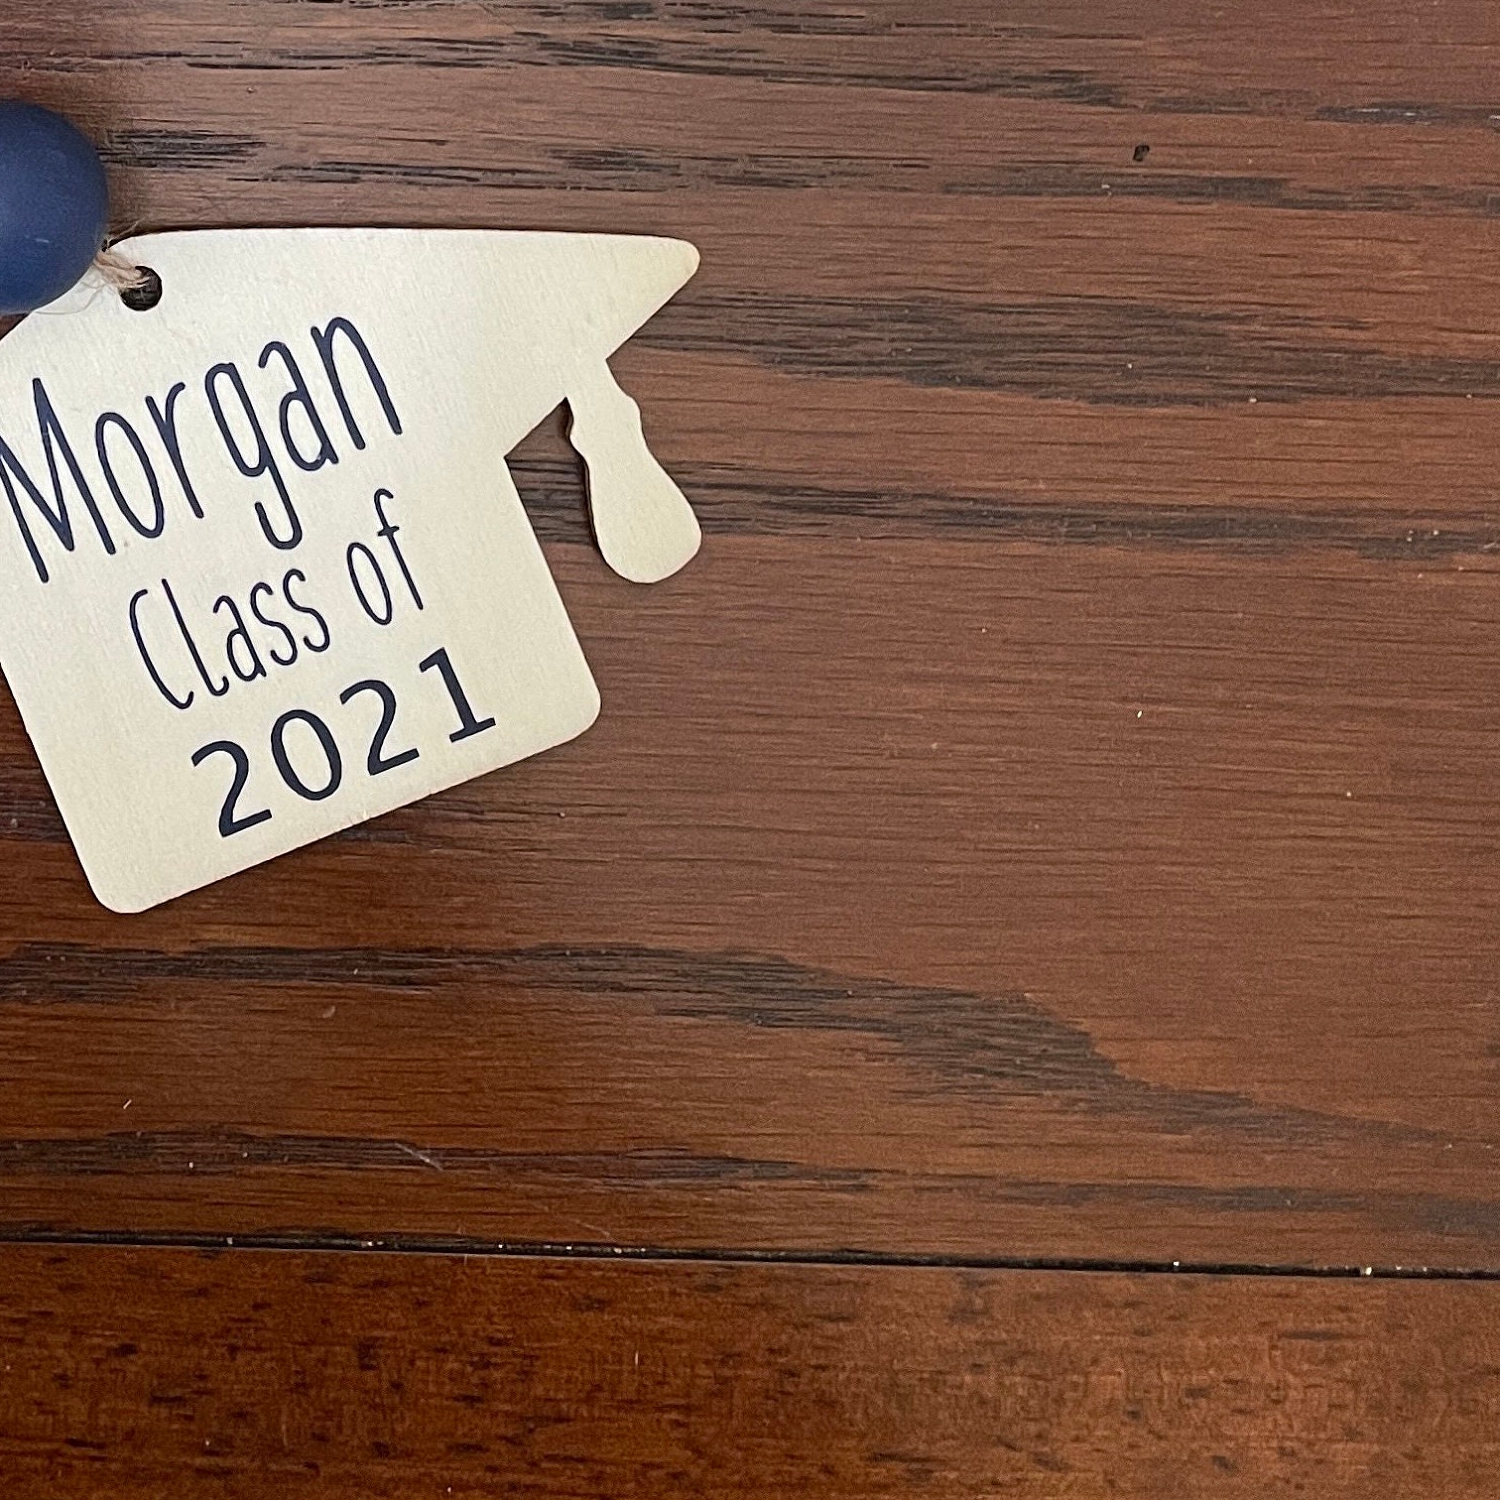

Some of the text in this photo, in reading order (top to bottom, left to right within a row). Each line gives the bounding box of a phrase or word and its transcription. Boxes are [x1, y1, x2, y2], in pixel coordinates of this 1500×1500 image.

[129, 488, 424, 710] Class of
[191, 646, 497, 838] 2021
